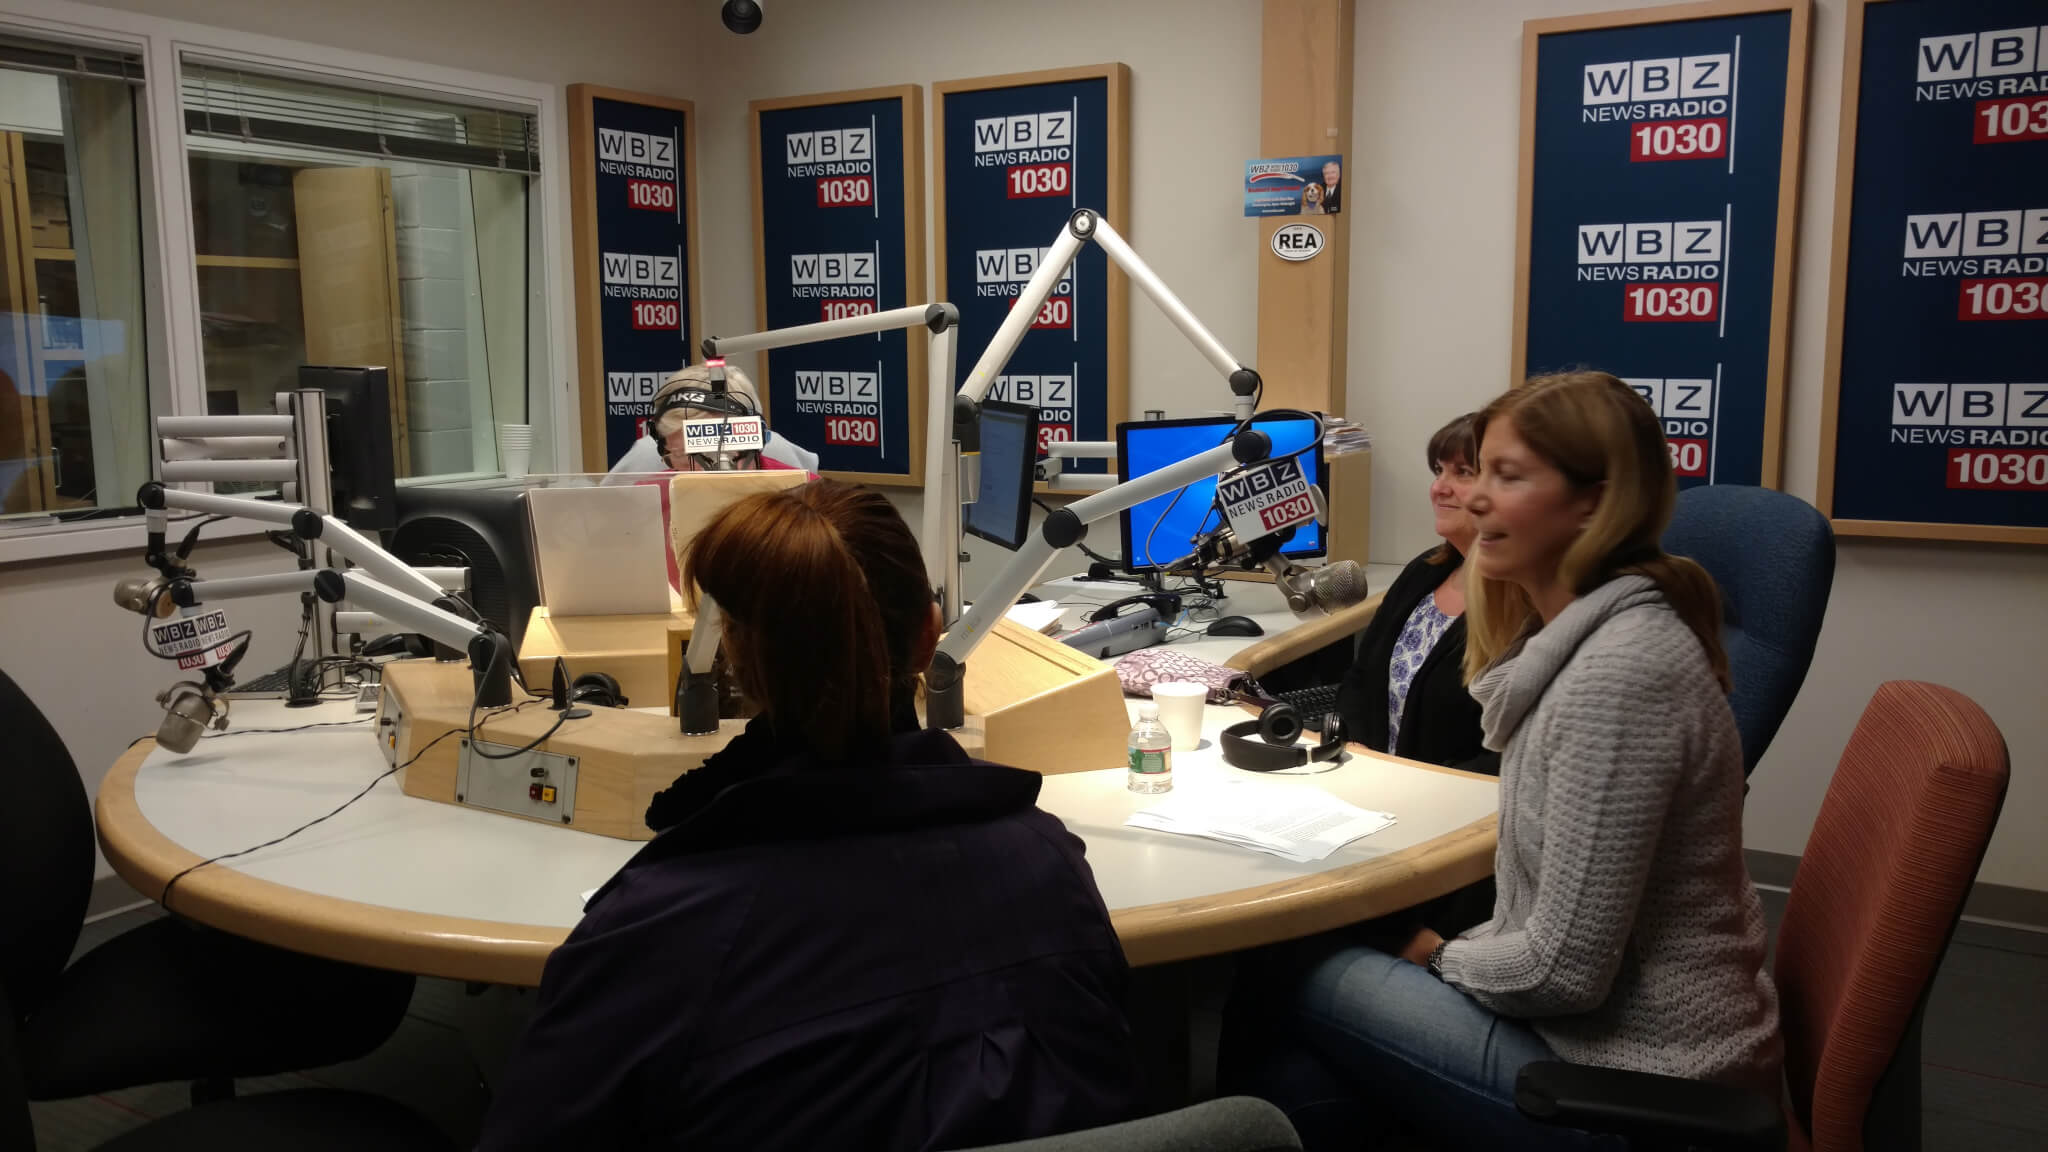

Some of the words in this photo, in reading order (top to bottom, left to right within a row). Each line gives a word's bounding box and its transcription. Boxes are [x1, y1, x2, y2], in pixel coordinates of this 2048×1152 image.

[1922, 36, 2025, 73] WB
[1587, 61, 1721, 97] WBZ
[976, 117, 1065, 146] WBZ
[1981, 101, 2048, 137] 103
[601, 133, 670, 161] WBZ
[788, 134, 866, 158] WBZ
[1635, 122, 1722, 156] 1030
[820, 179, 870, 203] 1030
[1010, 167, 1067, 194] 1030
[630, 182, 674, 208] 1030
[1279, 233, 1318, 249] REA
[1581, 228, 1713, 257] WBZ
[1909, 216, 2048, 250] WB
[605, 257, 674, 281] WBZ
[793, 258, 870, 279] WBZ
[978, 254, 1033, 276] WB
[1629, 287, 1713, 316] 1030
[1965, 281, 2048, 315] 103
[634, 303, 677, 326] 1030
[610, 377, 669, 397] WB
[797, 375, 873, 397] WBZ
[733, 422, 758, 434] 1030
[827, 419, 876, 442] 1030
[1222, 462, 1297, 501] WBZ
[1228, 498, 1265, 519] NEWS
[1266, 480, 1306, 504] RADIO
[1264, 497, 1311, 527] 1030
[154, 622, 196, 643] WBZ
